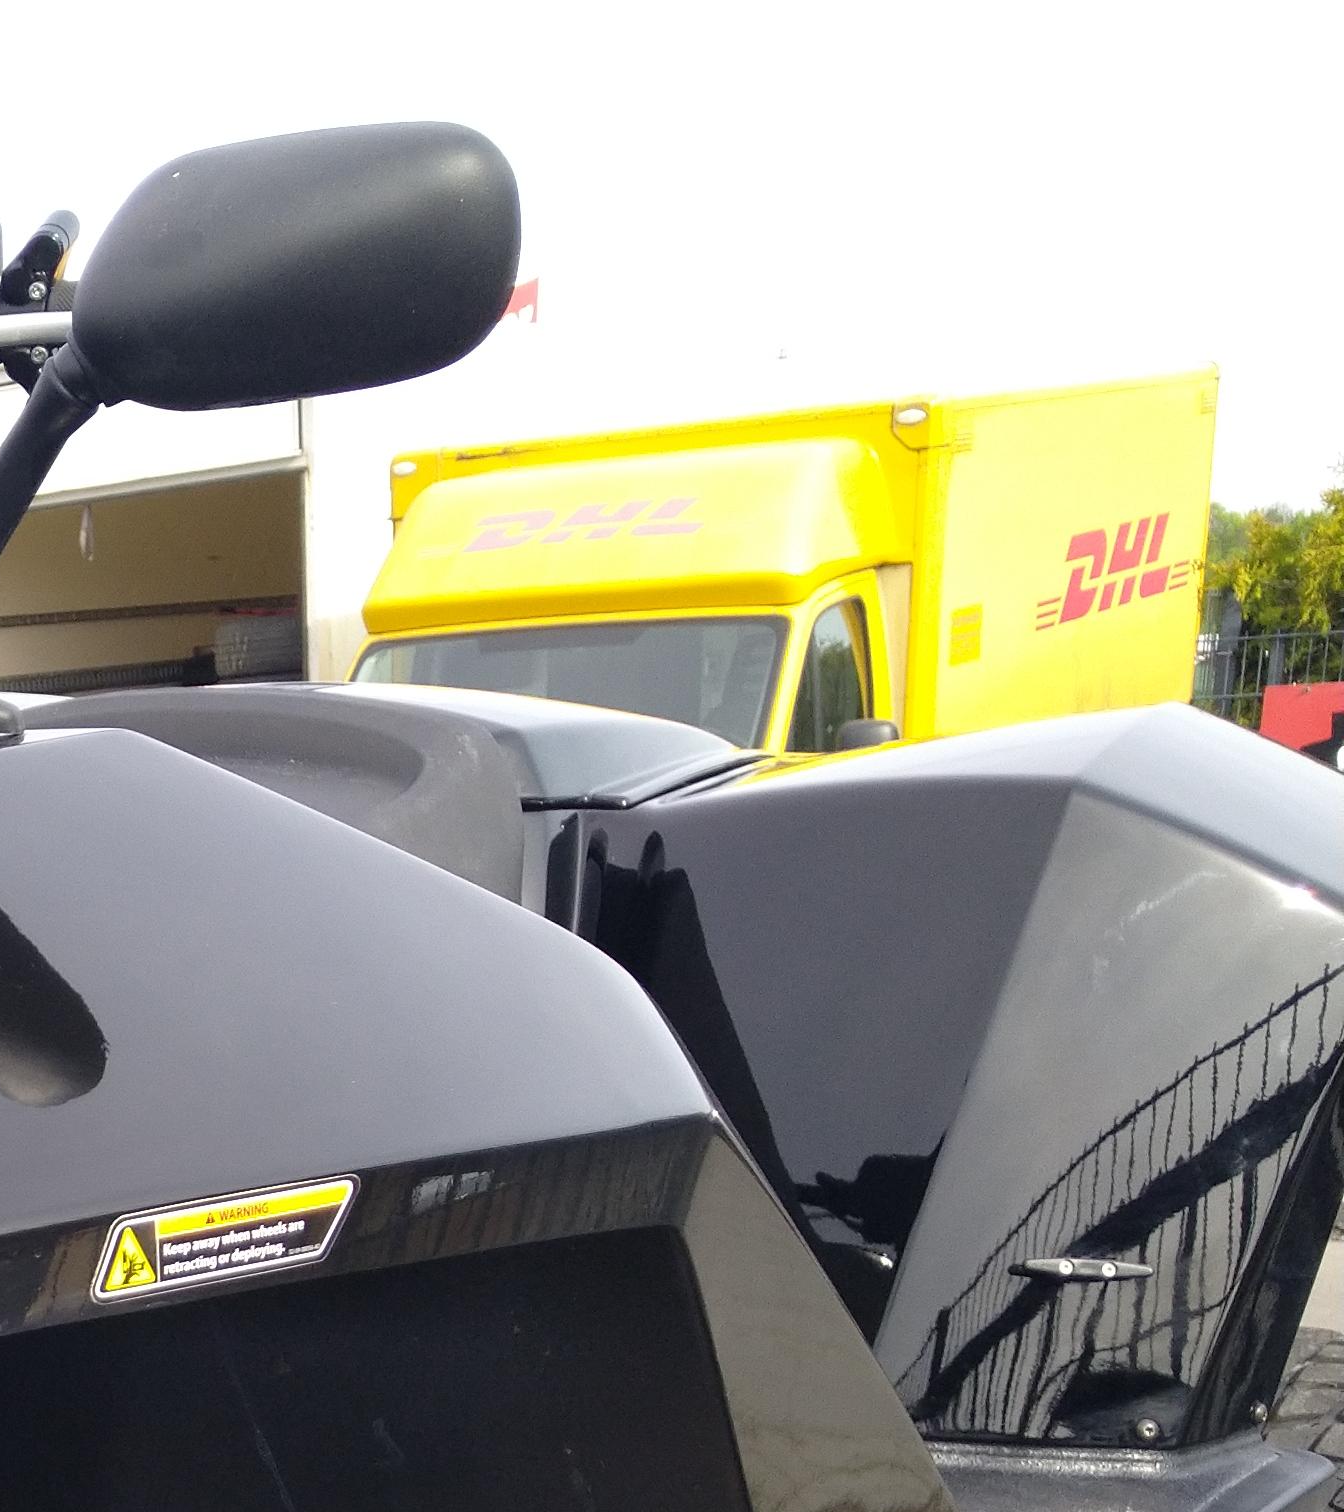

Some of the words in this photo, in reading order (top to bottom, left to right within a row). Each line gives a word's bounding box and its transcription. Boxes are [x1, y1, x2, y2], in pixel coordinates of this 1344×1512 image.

[463, 497, 703, 552] DHL
[1059, 511, 1170, 624] DHL
[219, 1203, 269, 1221] WARNING
[163, 1241, 192, 1256] Keep
[192, 1236, 221, 1251] away
[221, 1230, 251, 1245] when
[251, 1221, 288, 1239] wheels
[288, 1219, 305, 1233] are
[163, 1253, 218, 1275] retracting
[218, 1252, 231, 1264] or
[231, 1242, 286, 1262] deploying.
